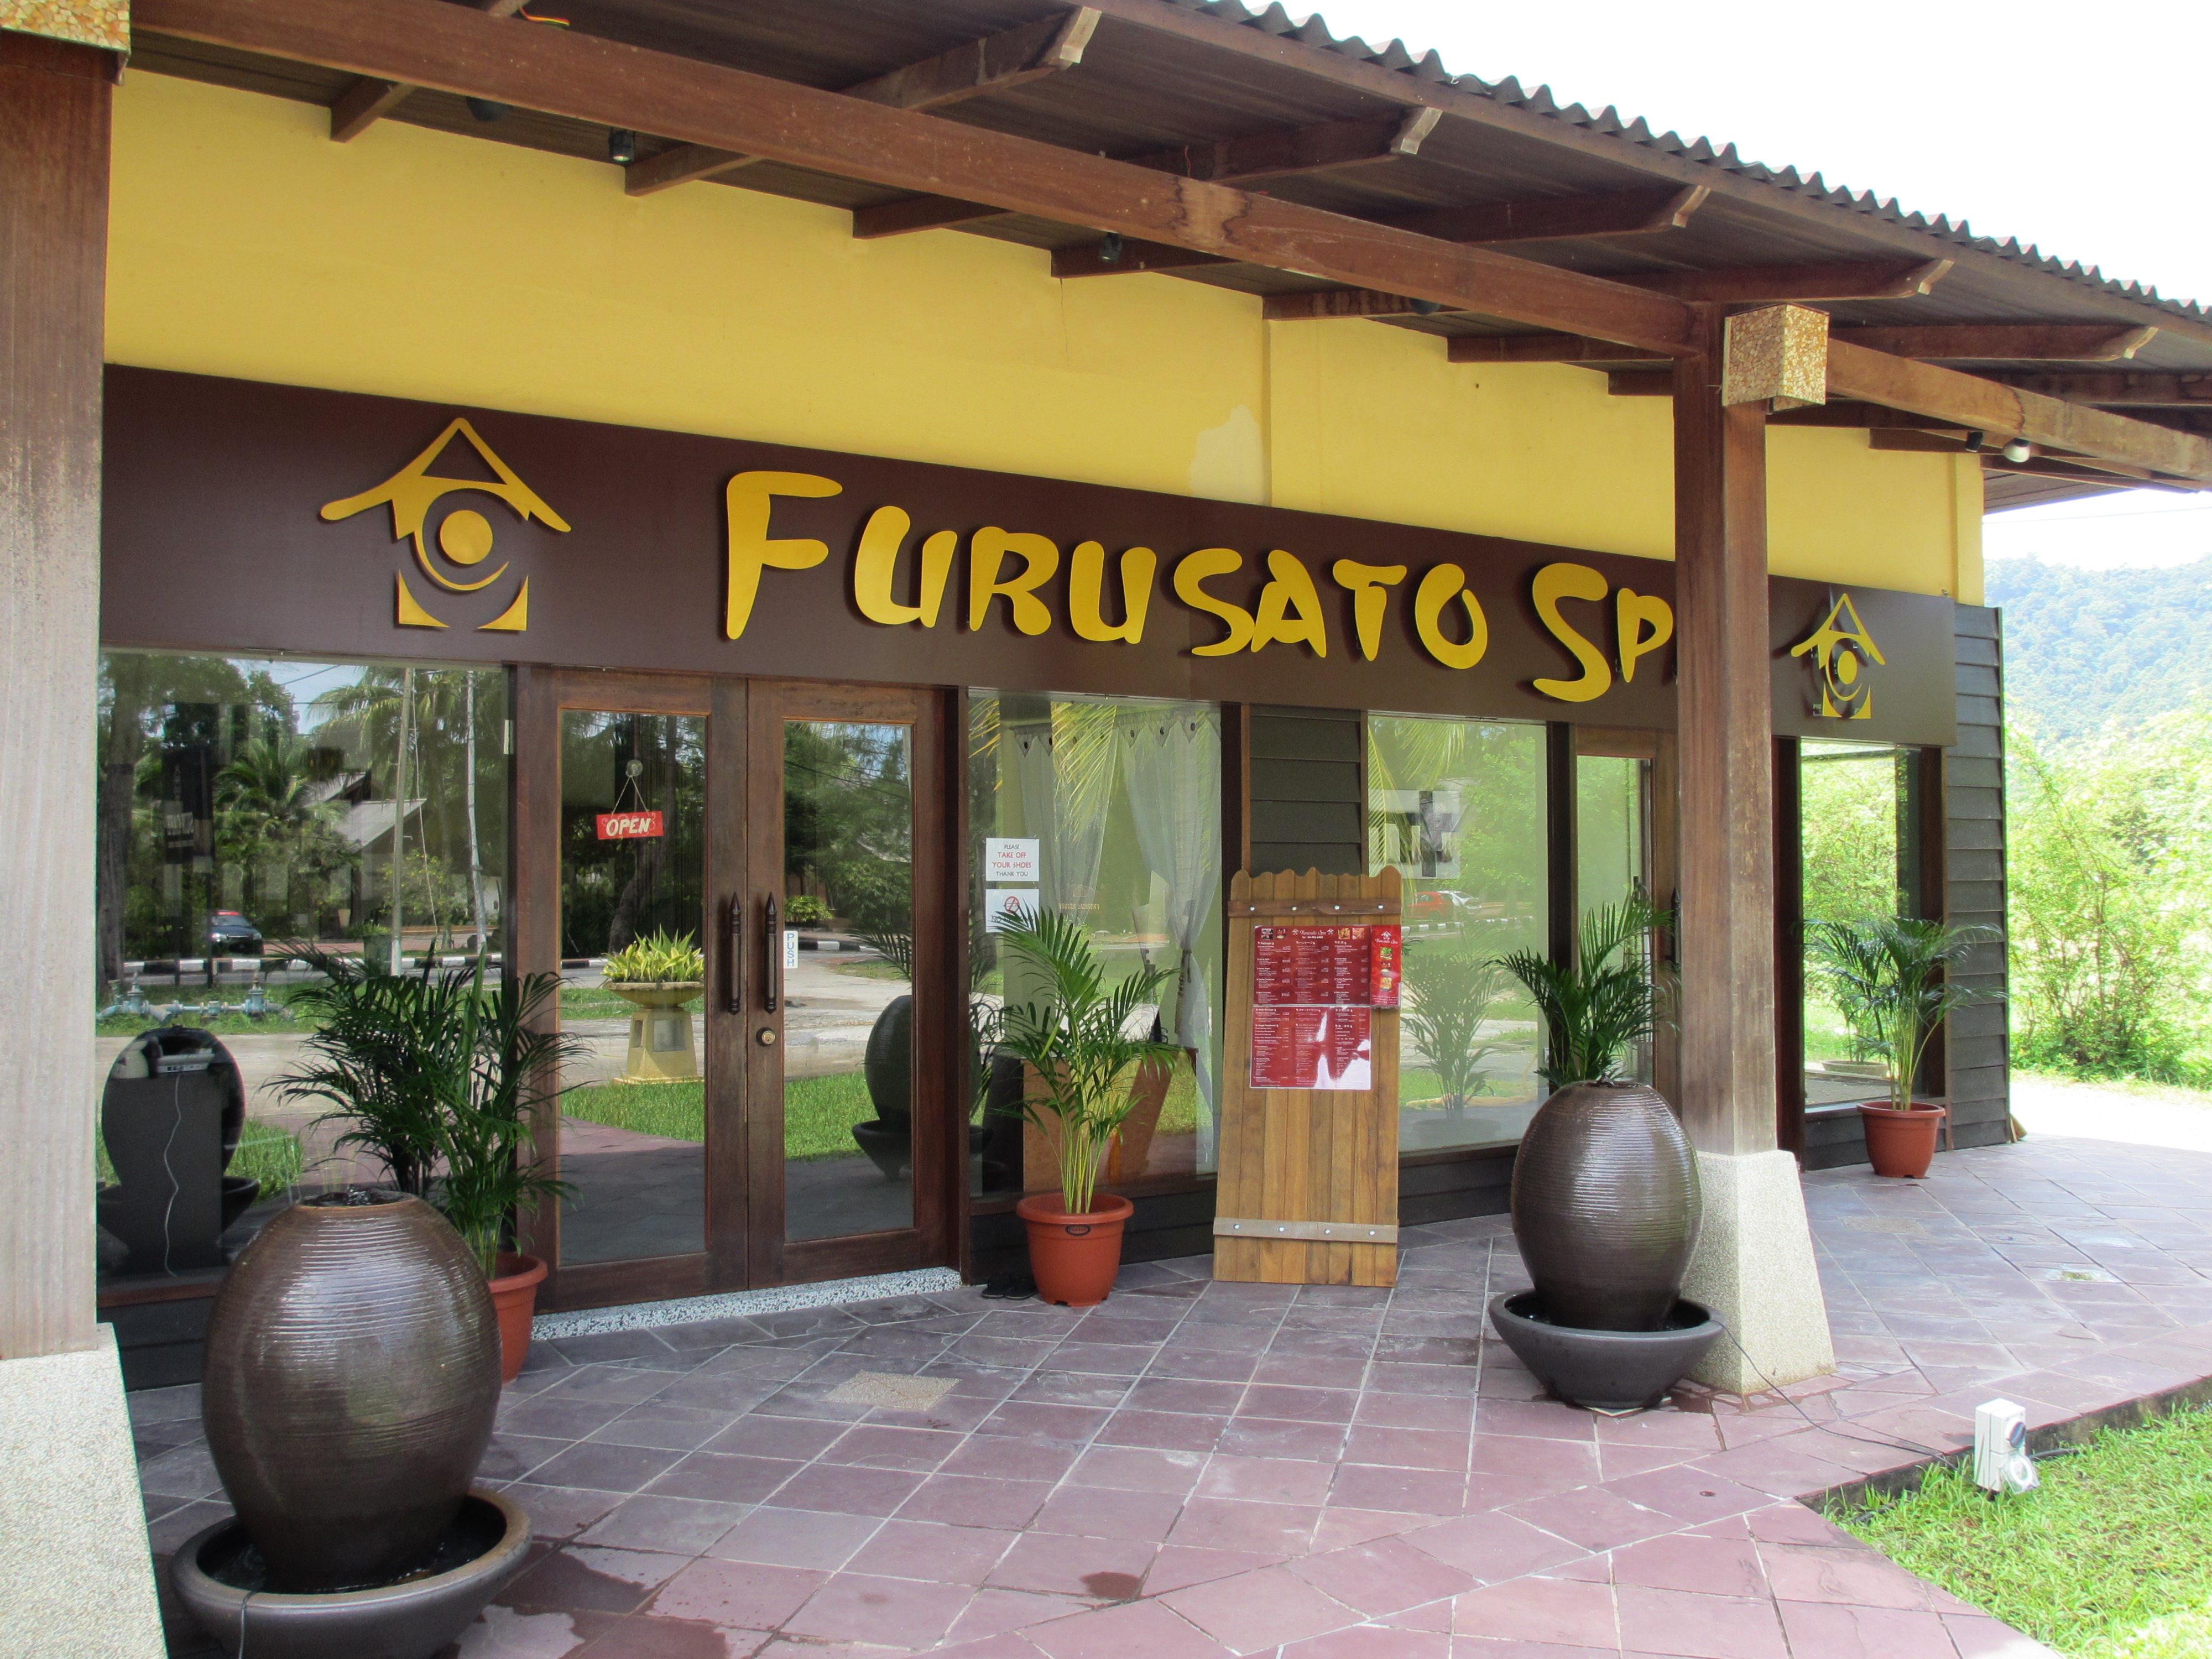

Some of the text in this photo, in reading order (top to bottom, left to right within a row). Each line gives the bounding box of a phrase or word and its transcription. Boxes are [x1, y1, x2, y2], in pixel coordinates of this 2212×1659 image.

[726, 471, 1674, 702] FURUSATO SP
[606, 817, 651, 837] OPEN
[787, 933, 795, 967] PUSH
